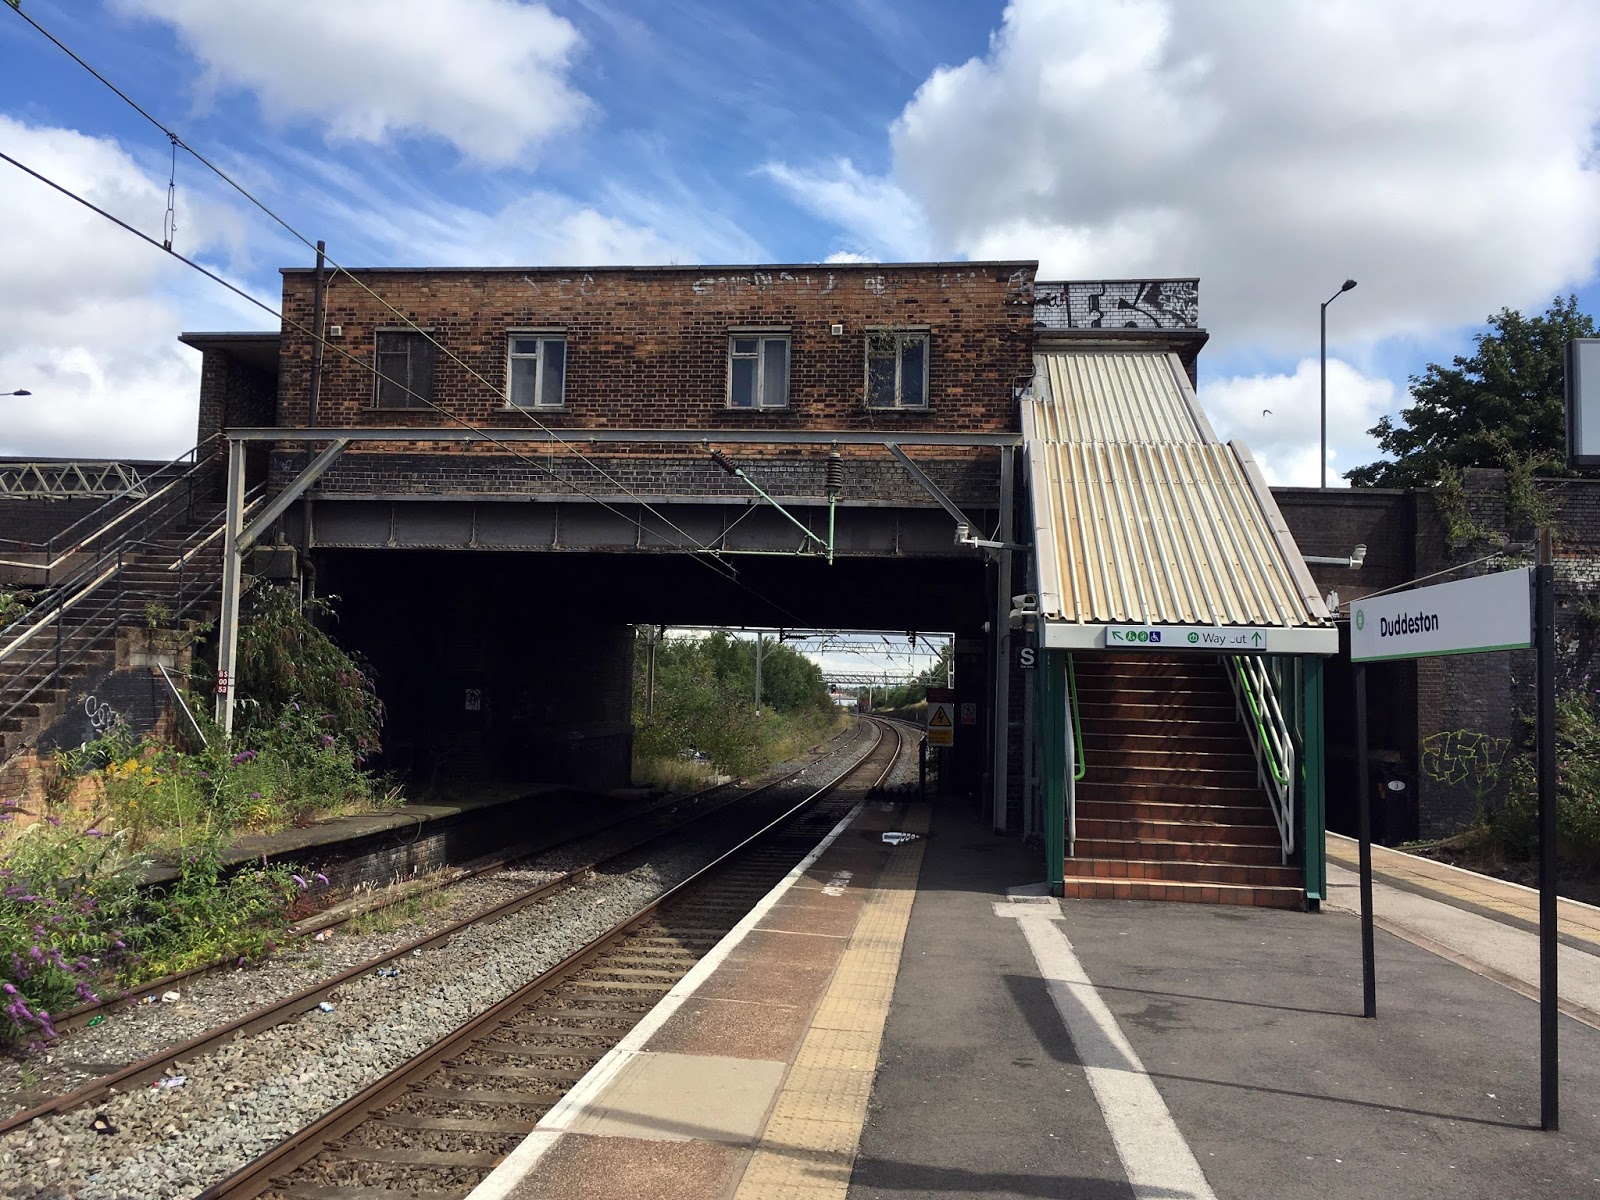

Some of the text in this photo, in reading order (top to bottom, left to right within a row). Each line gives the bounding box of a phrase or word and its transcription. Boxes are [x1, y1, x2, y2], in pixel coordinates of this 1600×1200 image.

[1380, 611, 1439, 637] Duddeston
[1202, 633, 1226, 646] Way
[1020, 648, 1035, 665] S
